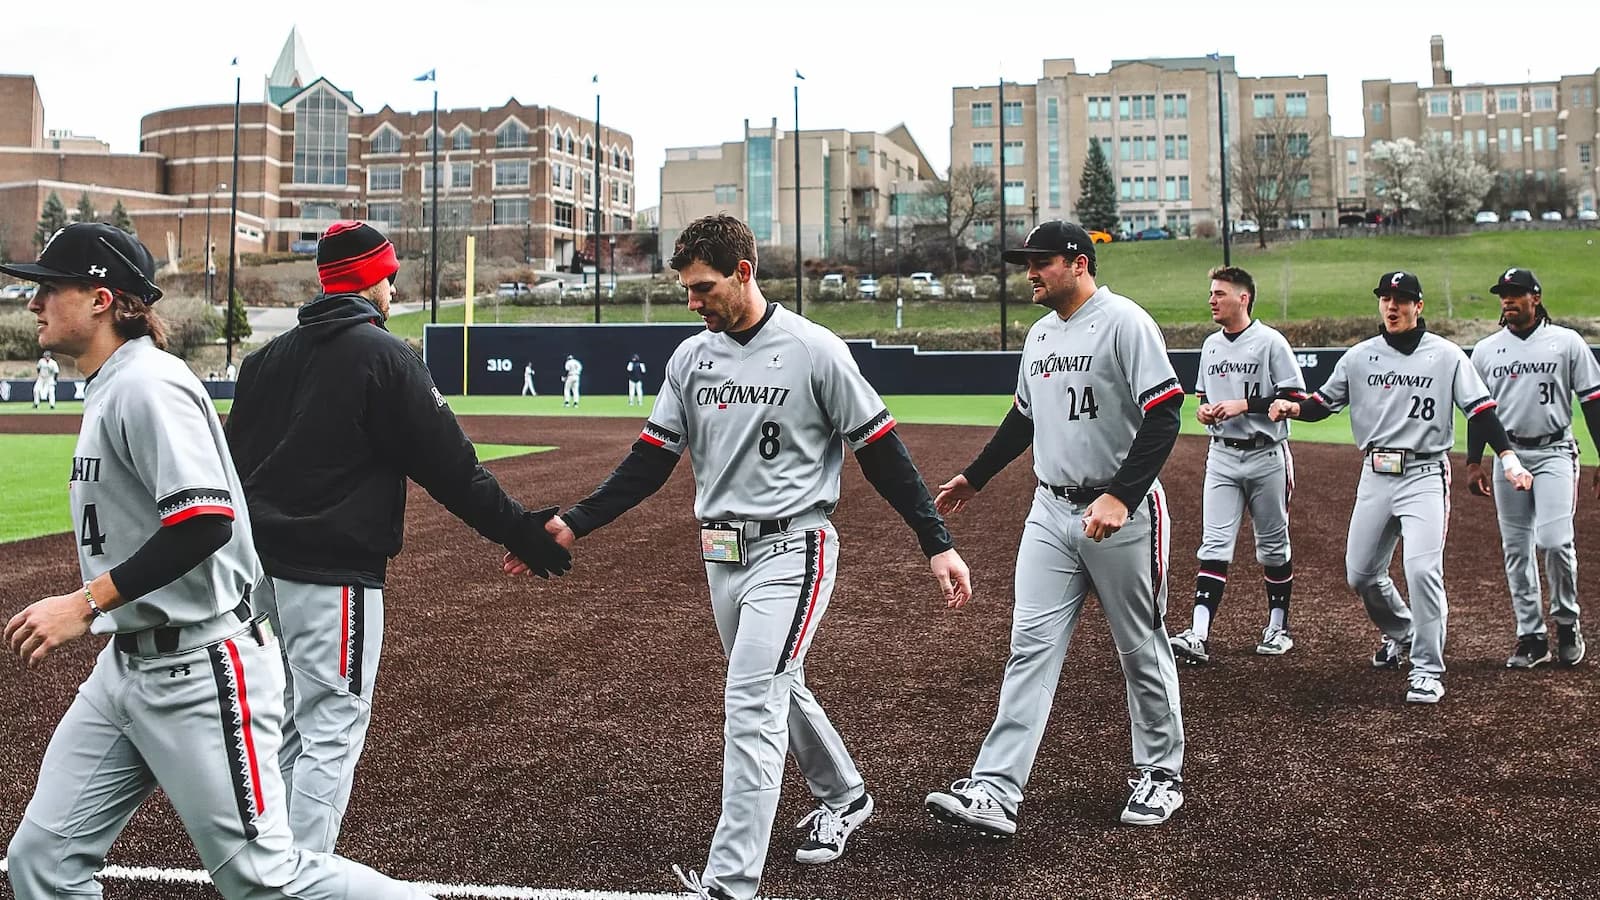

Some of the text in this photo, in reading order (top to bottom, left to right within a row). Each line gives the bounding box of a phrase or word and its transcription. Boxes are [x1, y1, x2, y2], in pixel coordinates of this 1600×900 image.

[487, 359, 512, 371] 310
[1030, 354, 1093, 378] CINCINNATI
[1208, 360, 1259, 377] CINCINNATI
[1493, 361, 1557, 379] CINCINNATI
[1368, 373, 1433, 390] CINCINNATI
[696, 381, 791, 408] CINCINNATI
[1068, 387, 1098, 421] 24
[1539, 383, 1556, 405] 31
[1408, 396, 1435, 421] 28
[759, 421, 781, 460] 8
[81, 503, 106, 556] 4
